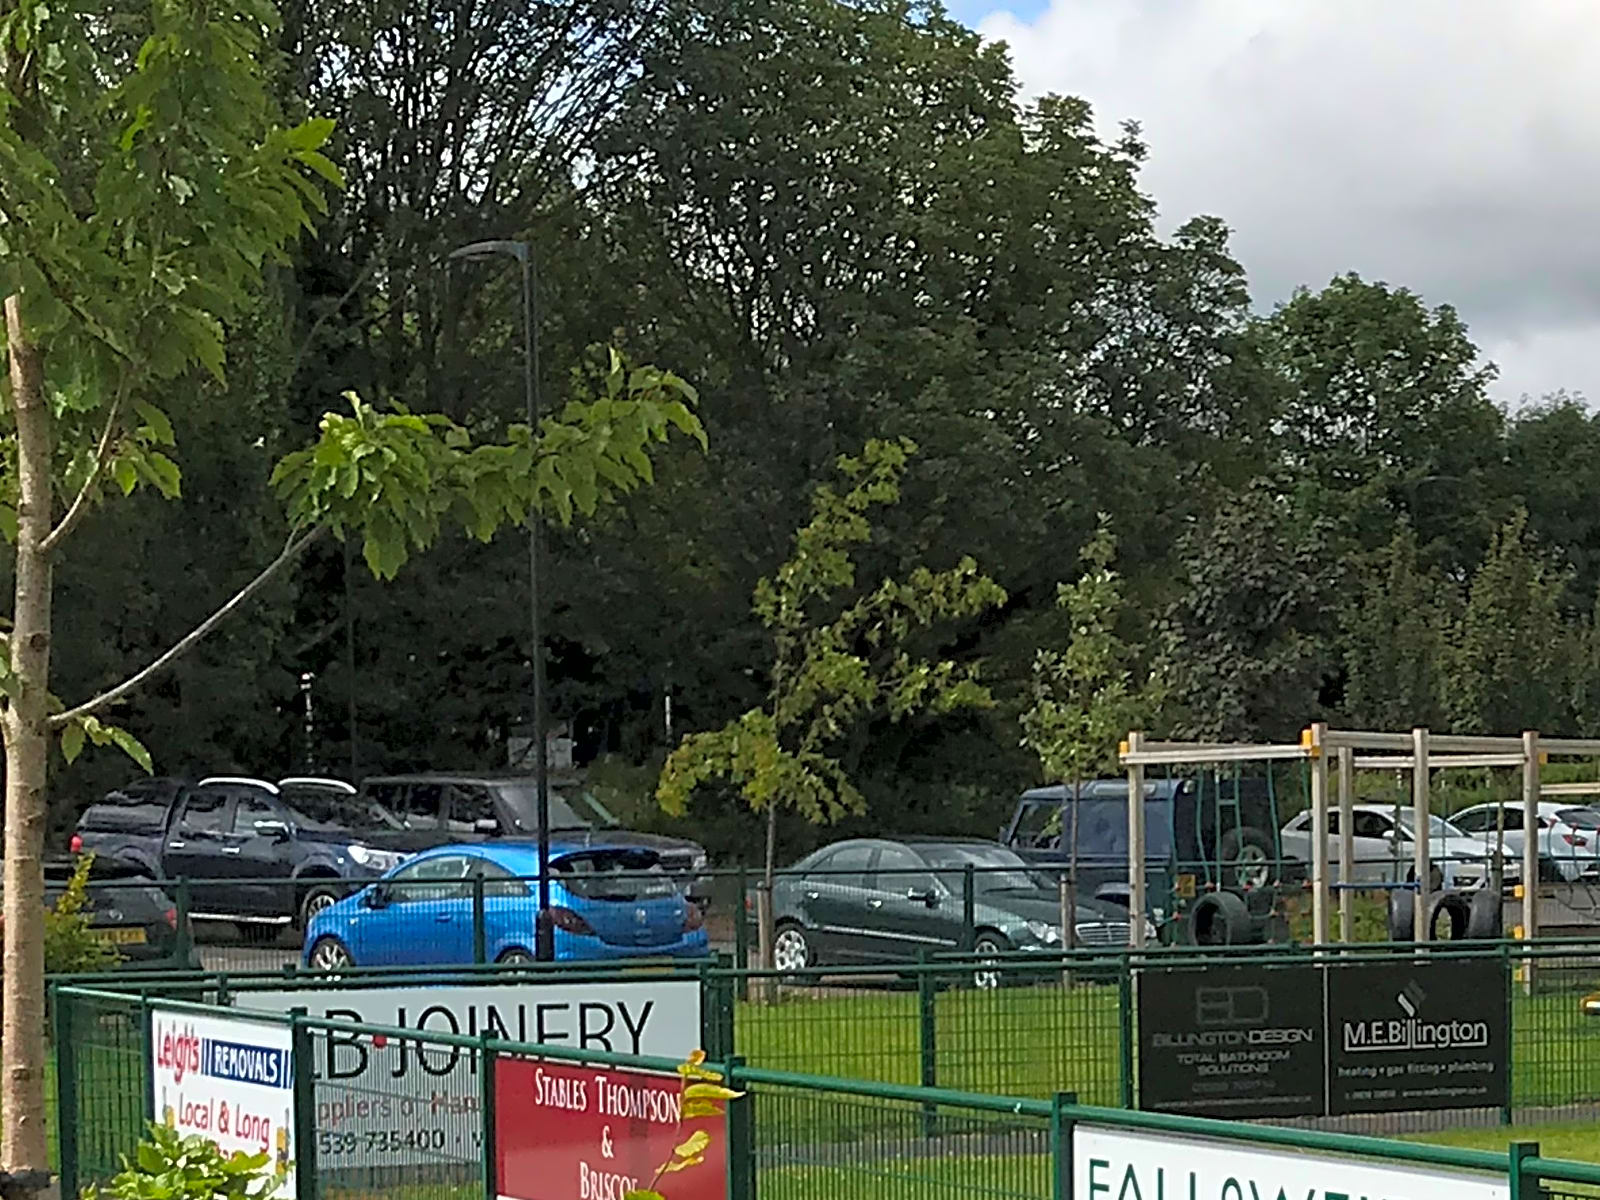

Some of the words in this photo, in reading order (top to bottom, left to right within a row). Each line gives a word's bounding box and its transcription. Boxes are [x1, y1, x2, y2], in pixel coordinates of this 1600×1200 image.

[392, 1001, 654, 1078] JOINERY
[214, 1045, 278, 1083] REMOVALS
[319, 1090, 392, 1126] ppliers
[535, 1068, 587, 1112] STABLES
[595, 1076, 682, 1124] THOMPSON
[179, 1093, 213, 1131] Local
[218, 1100, 230, 1134] &
[235, 1103, 270, 1154] Long
[602, 1125, 614, 1158] &
[320, 1132, 357, 1154] 539
